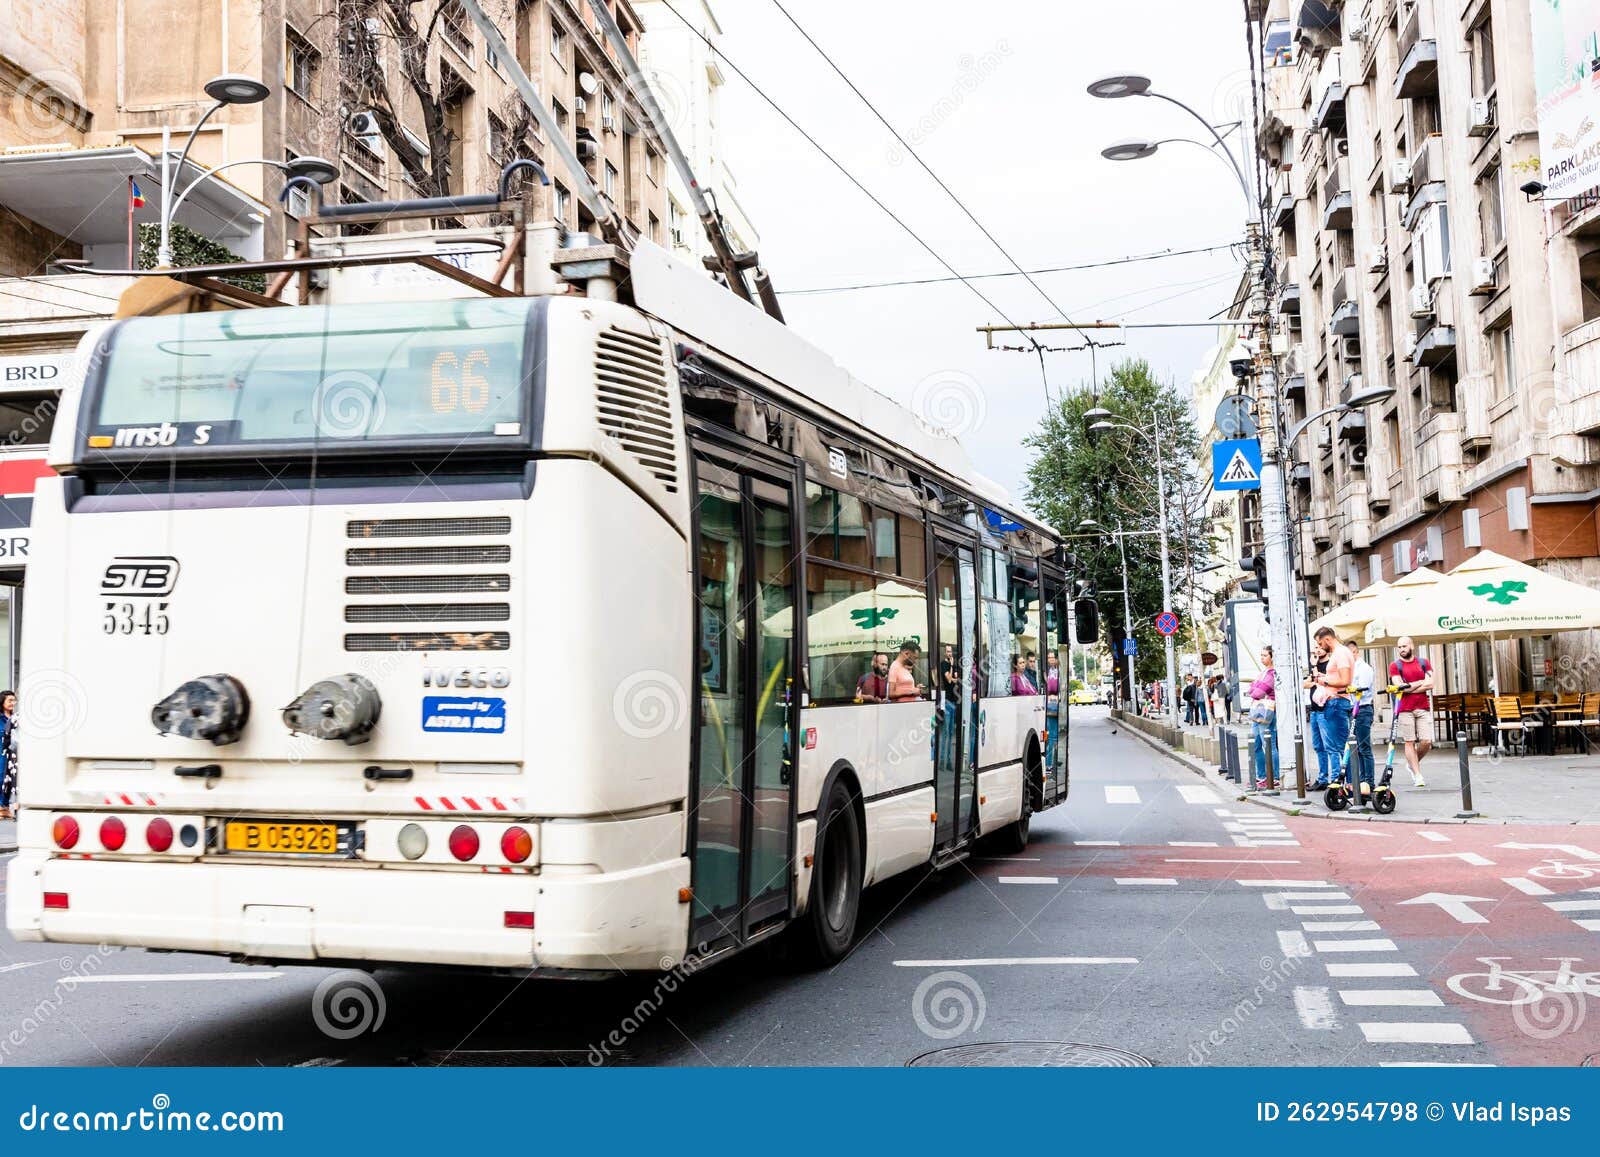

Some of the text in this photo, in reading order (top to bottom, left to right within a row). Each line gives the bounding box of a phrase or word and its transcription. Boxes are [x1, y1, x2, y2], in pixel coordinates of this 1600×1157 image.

[6, 365, 58, 381] BRD
[431, 349, 489, 414] 66
[101, 564, 171, 588] STB
[104, 603, 170, 635] 5345
[1437, 614, 1483, 631] Carlsberg
[423, 666, 511, 688] IVECO
[246, 825, 332, 850] B 05926
